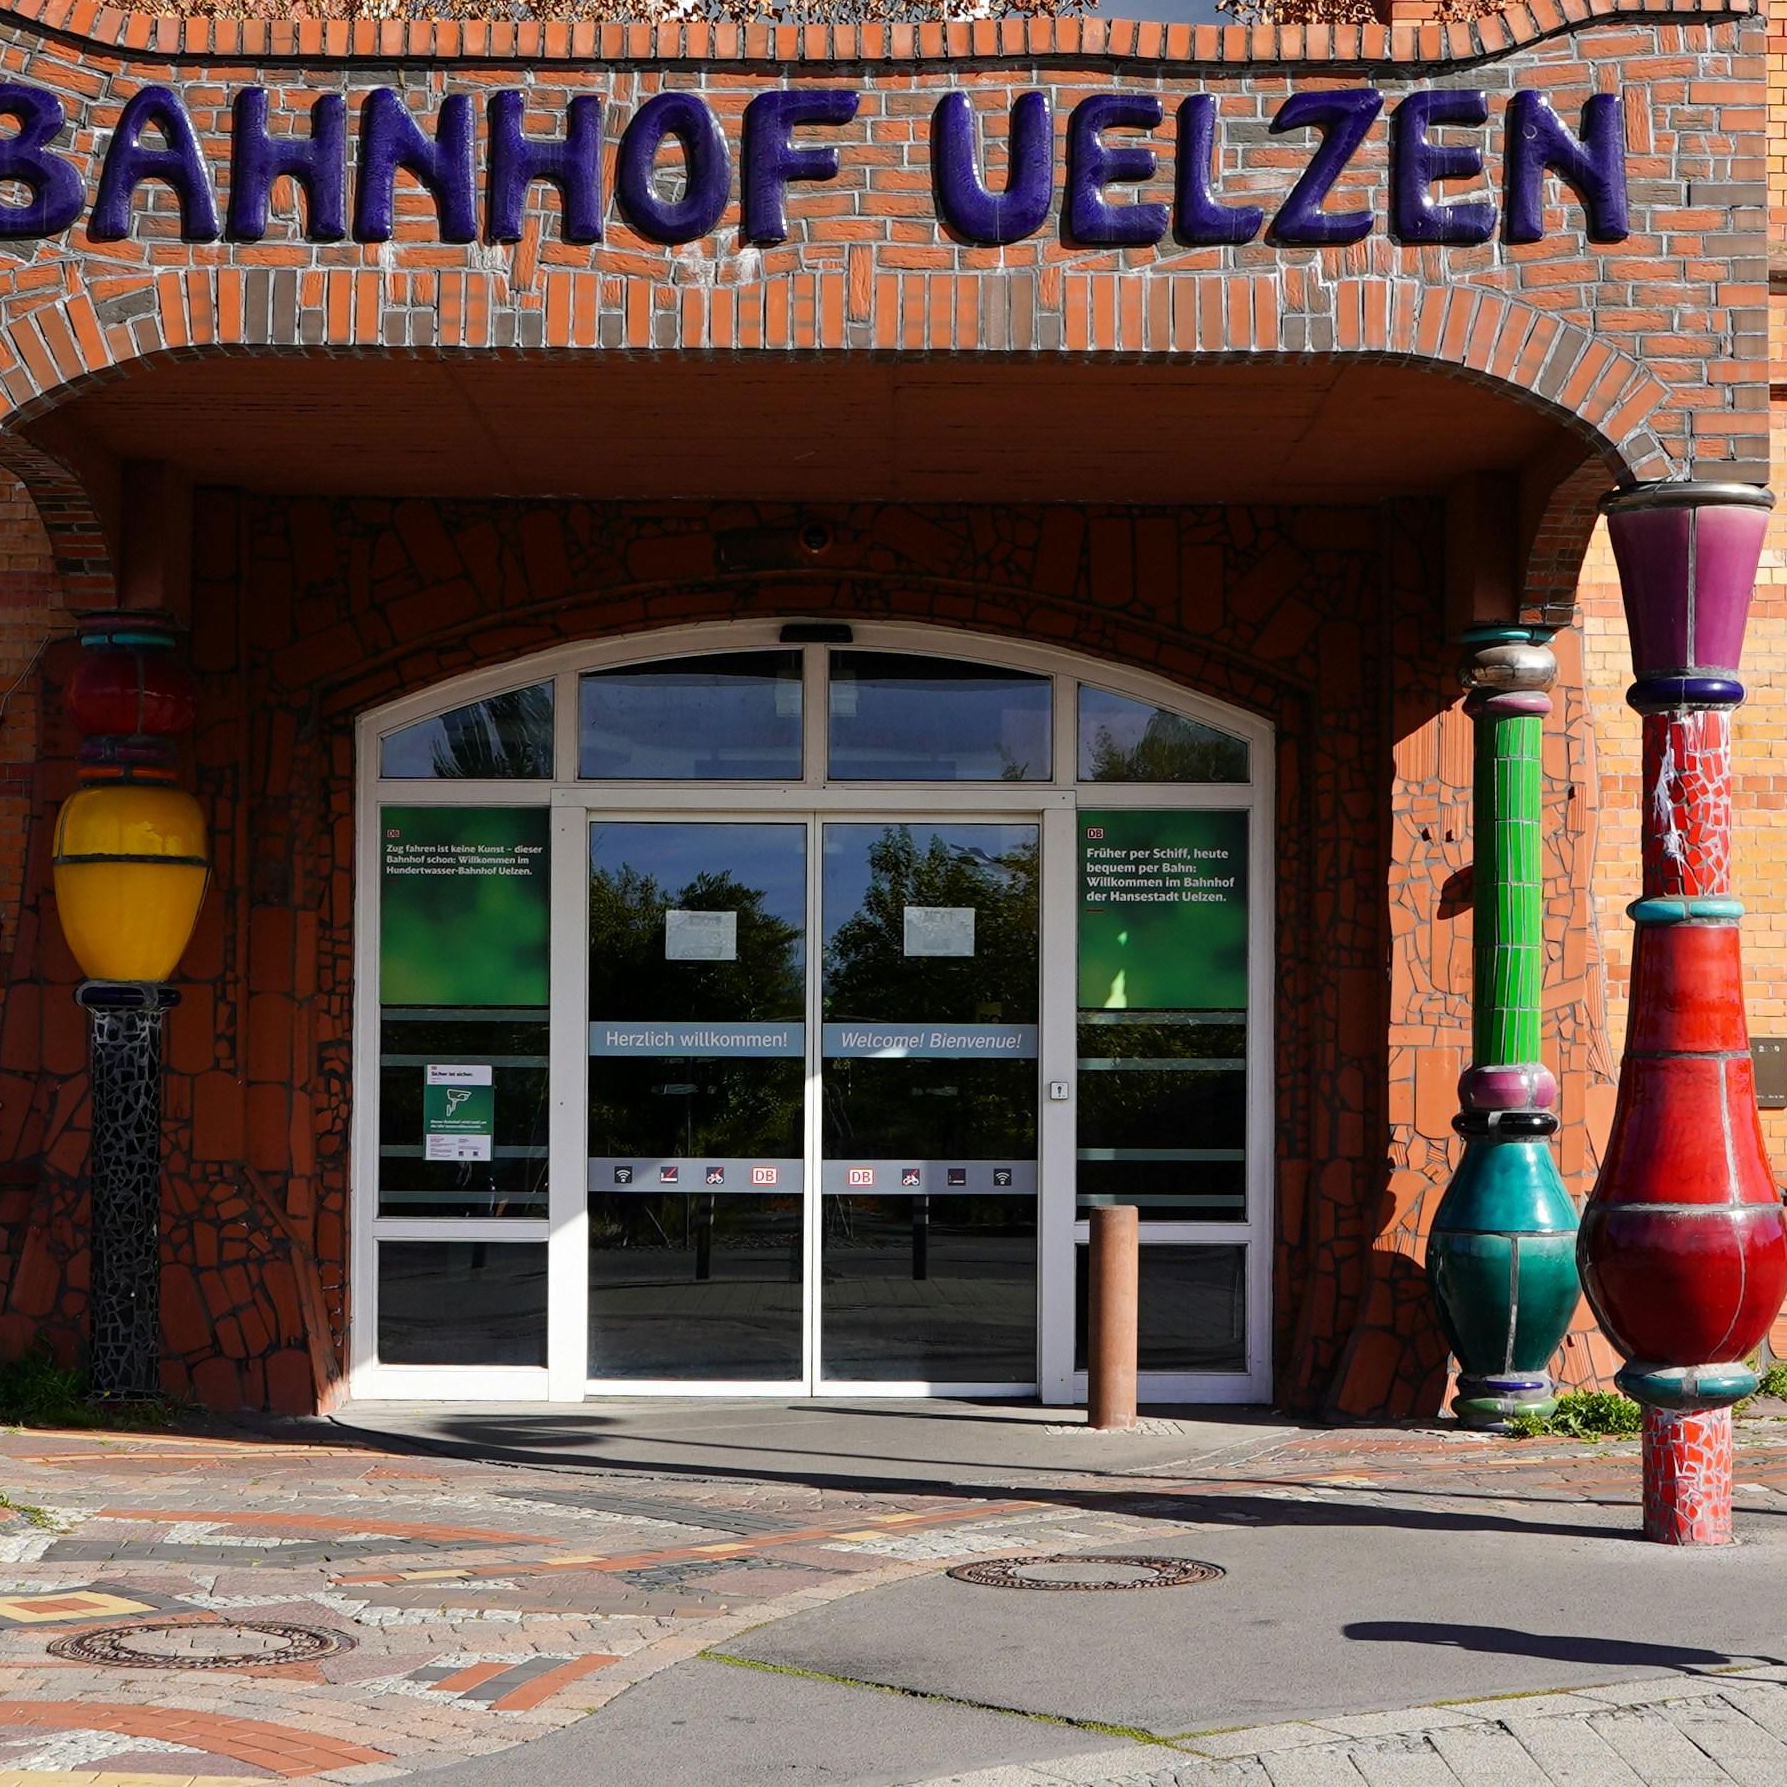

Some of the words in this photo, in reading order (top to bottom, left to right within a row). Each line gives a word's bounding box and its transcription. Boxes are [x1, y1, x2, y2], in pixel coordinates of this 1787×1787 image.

[931, 87, 1630, 247] UELZEN
[1089, 829, 1103, 838] DB
[386, 845, 404, 854] Zug
[406, 845, 435, 853] fahren
[437, 845, 449, 853] ist
[451, 845, 475, 853] keine
[478, 845, 504, 853] Kunst
[514, 845, 542, 854] dieser
[1086, 848, 1126, 858] Früher
[1129, 851, 1150, 860] per
[1153, 848, 1191, 859] Schiff,
[1194, 849, 1228, 858] heute
[386, 856, 425, 864] Bahnhof
[427, 856, 456, 864] schon:
[458, 856, 515, 864] Willkommen
[518, 856, 529, 864] im
[386, 867, 497, 875] Hundertwasser-Bahnhof
[498, 867, 532, 875] Uelzen.
[1086, 863, 1135, 874] bequem
[1139, 866, 1159, 875] per
[1162, 863, 1196, 873] Bahn:
[1086, 877, 1162, 887] Willkommen
[1165, 877, 1180, 887] im
[1183, 877, 1235, 888] Bahnhof
[1086, 891, 1107, 902] der
[1110, 891, 1179, 902] Hansestadt
[1182, 892, 1227, 902] Uelzen.
[606, 1031, 674, 1047] Herzlich
[680, 1032, 788, 1047] willkommen!
[842, 1032, 924, 1048] Welcome!
[930, 1033, 1022, 1049] Bienvenue!
[755, 1170, 774, 1181] DB
[852, 1172, 871, 1182] DB
